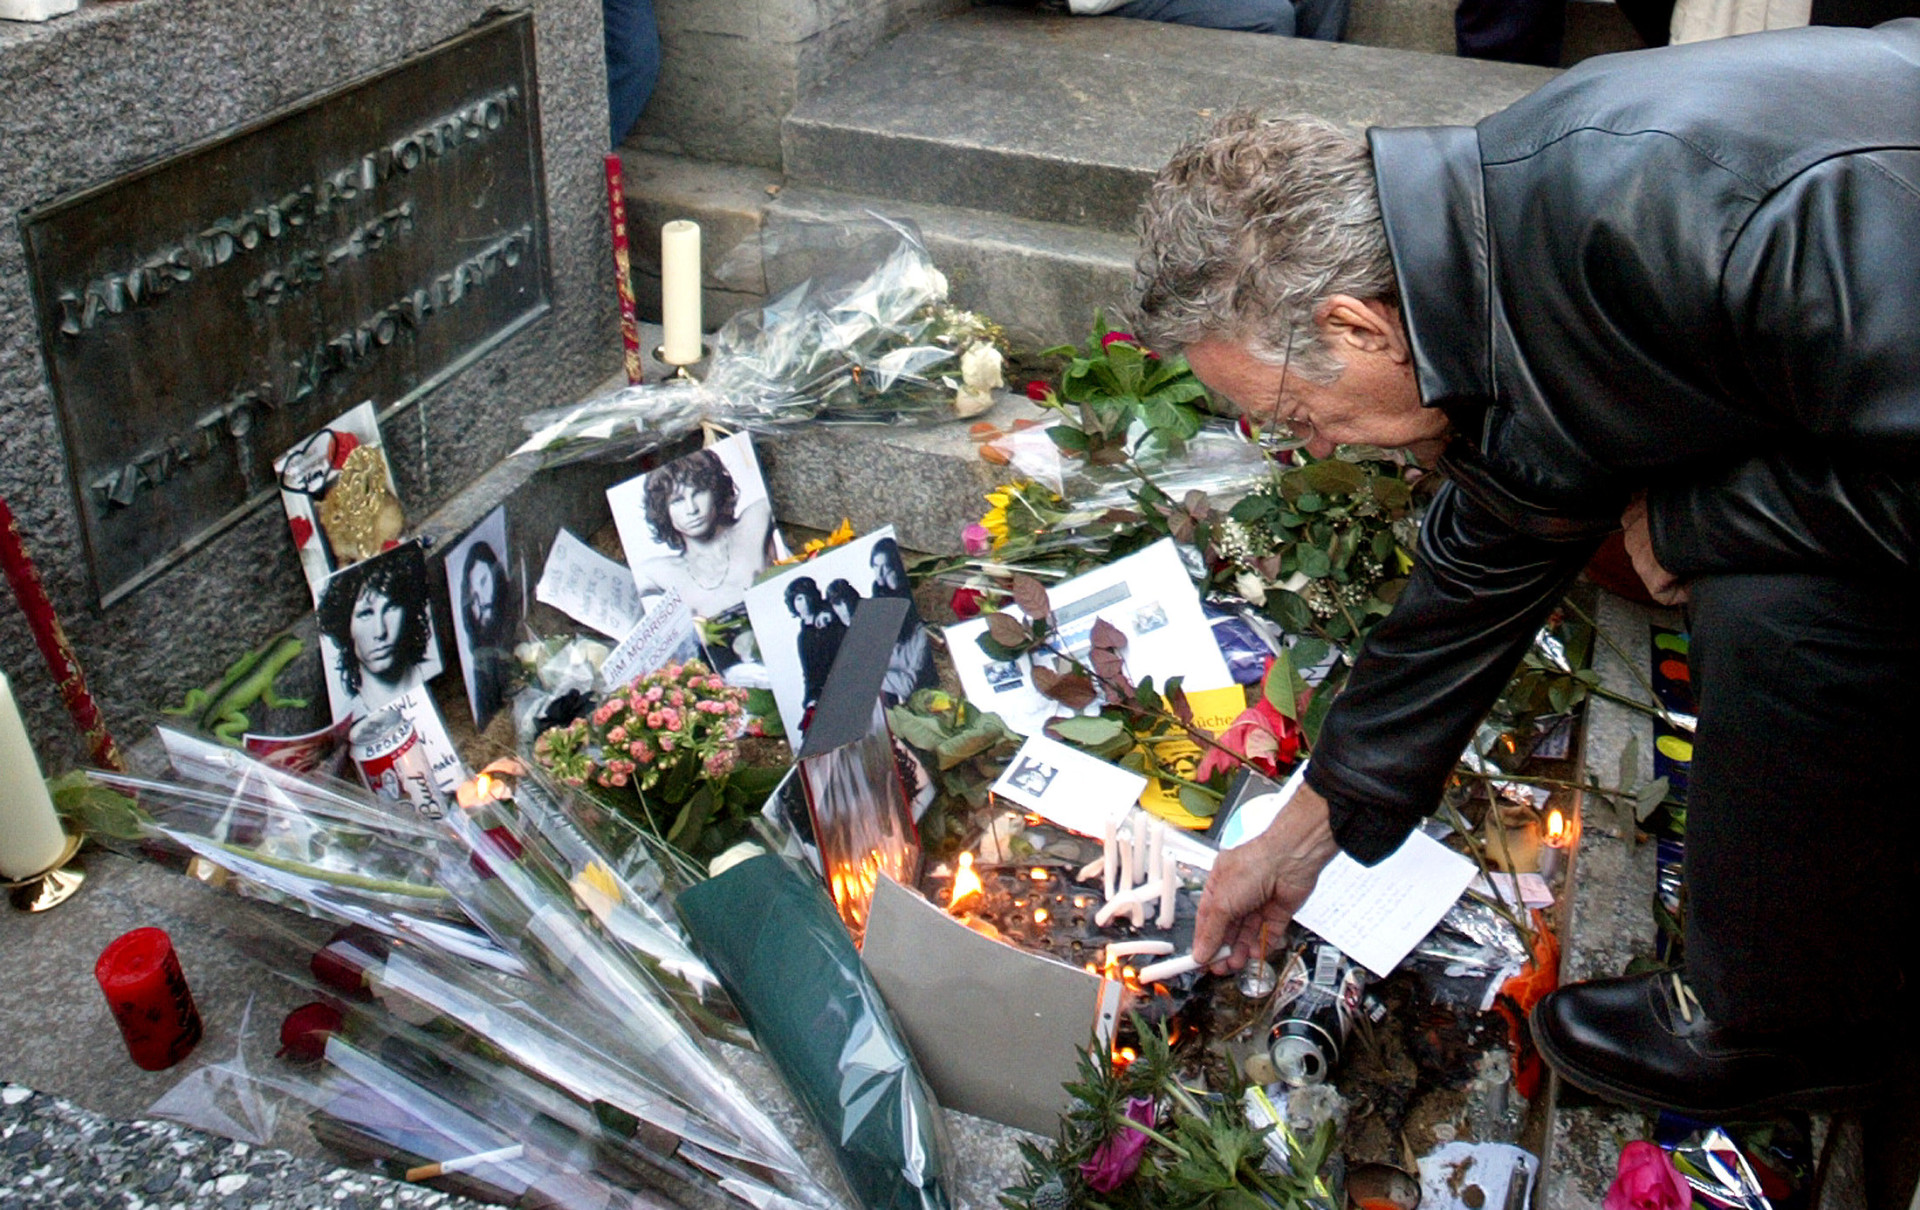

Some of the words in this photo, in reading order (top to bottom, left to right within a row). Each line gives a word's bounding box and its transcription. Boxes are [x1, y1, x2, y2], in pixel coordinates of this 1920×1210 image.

[362, 86, 519, 192] MORRISON
[608, 658, 628, 685] JIM
[626, 593, 683, 661] MORRISON
[649, 627, 680, 667] DOORS
[407, 771, 444, 820] Bud
